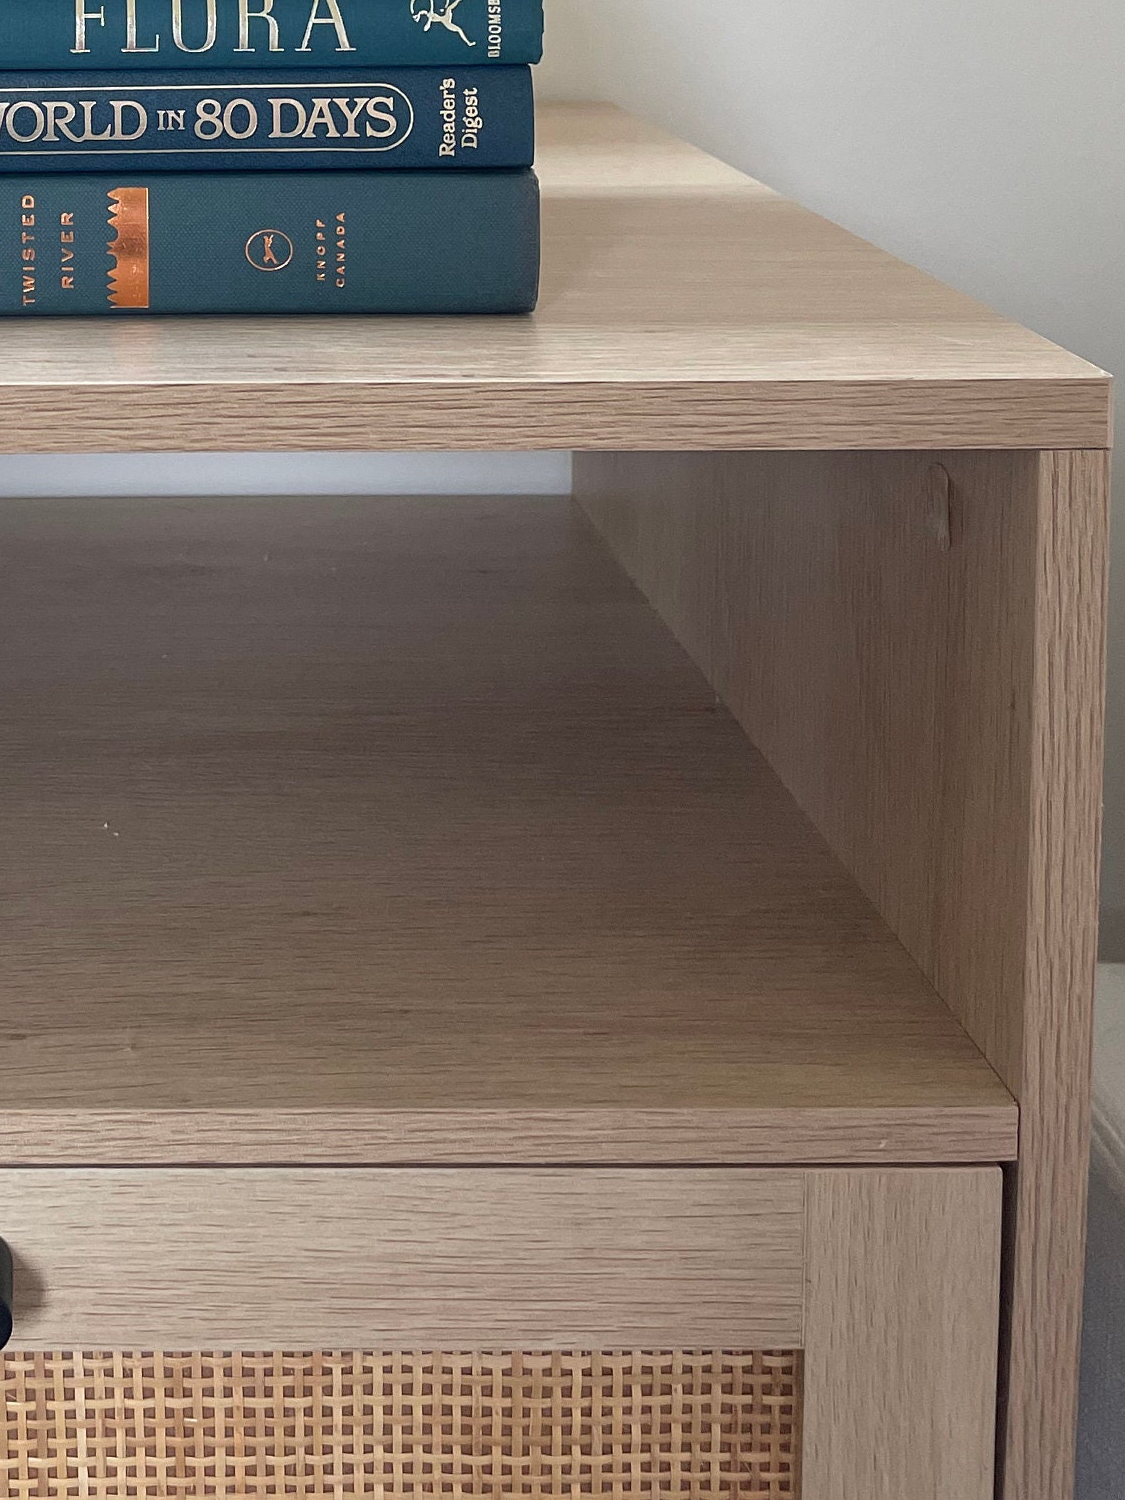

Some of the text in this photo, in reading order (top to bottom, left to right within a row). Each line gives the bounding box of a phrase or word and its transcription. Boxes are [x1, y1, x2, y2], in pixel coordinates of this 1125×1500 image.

[156, 109, 186, 131] IN
[194, 98, 258, 140] 80
[268, 96, 398, 140] DAYS
[438, 78, 457, 157] Reader's
[461, 87, 483, 149] Digest
[21, 194, 36, 305] TWISTED
[60, 212, 74, 289] RIVER
[315, 219, 326, 281] KNOPF
[335, 212, 346, 287] CANADA
